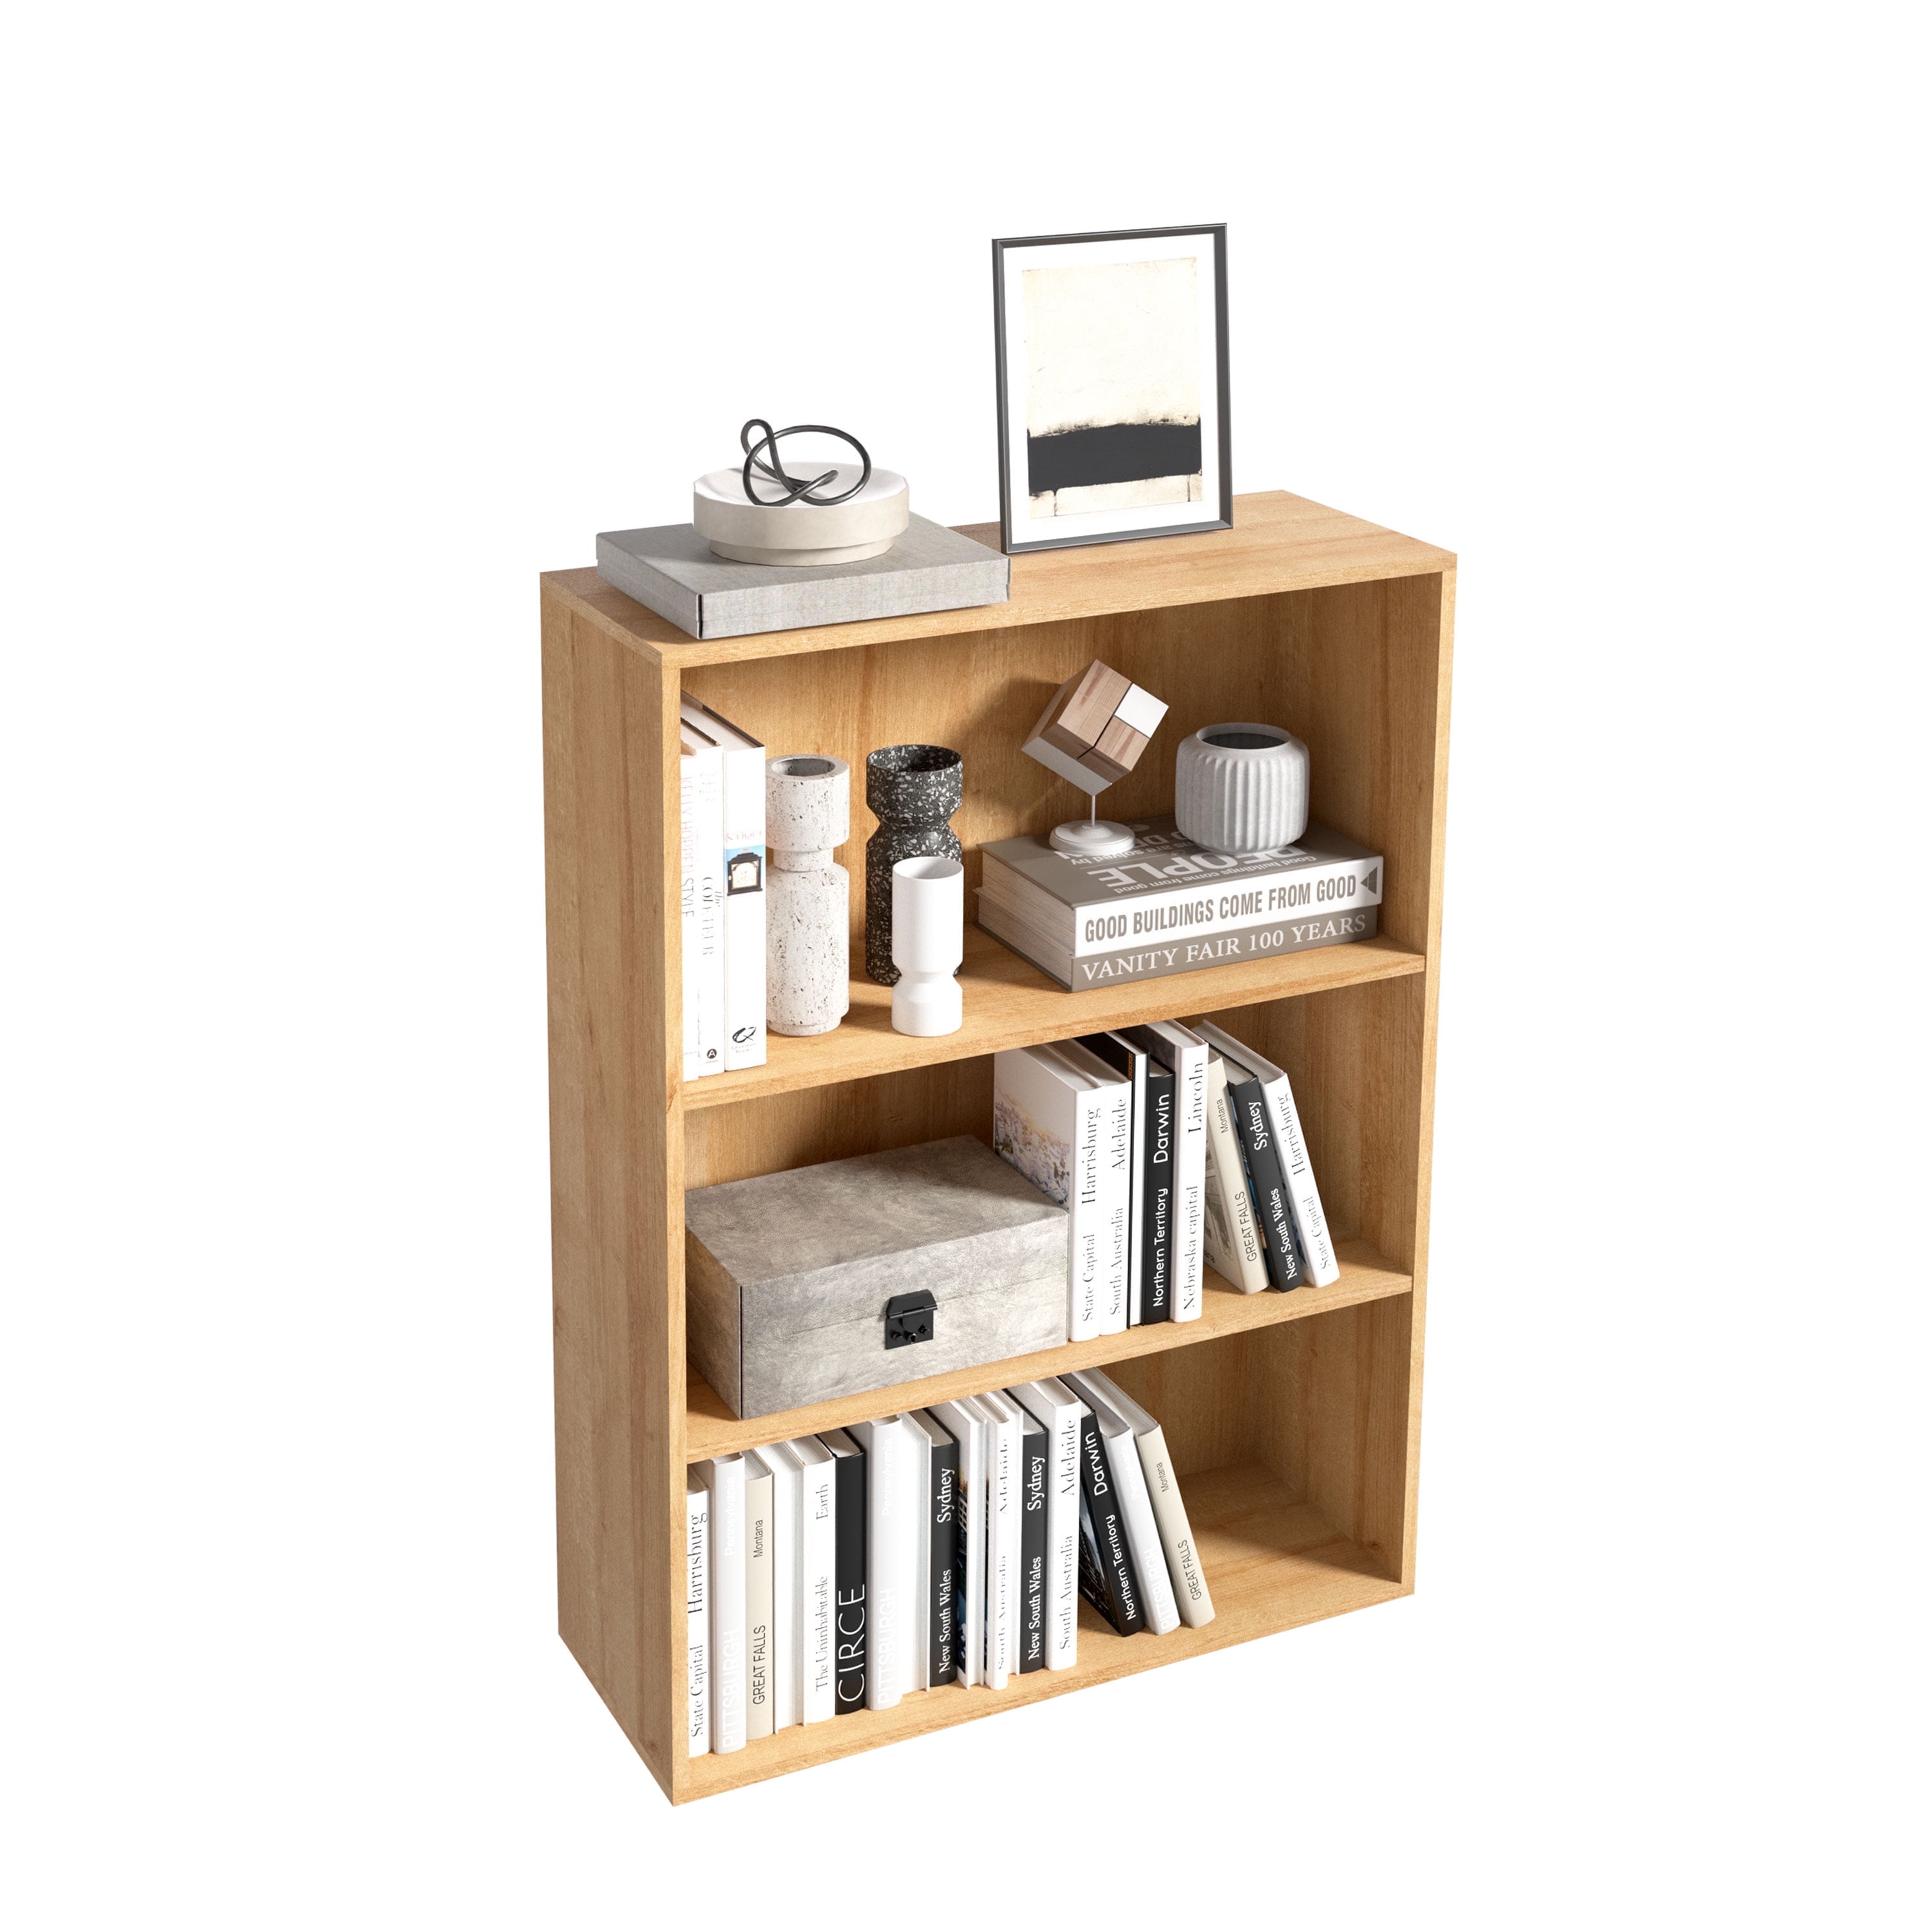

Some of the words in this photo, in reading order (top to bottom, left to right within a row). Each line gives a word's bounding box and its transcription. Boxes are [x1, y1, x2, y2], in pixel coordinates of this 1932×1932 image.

[1149, 878, 1181, 888] from
[1182, 872, 1220, 882] come
[1221, 861, 1281, 875] buildings
[1282, 855, 1317, 866] Good
[1085, 914, 1126, 943] GOOD
[1133, 899, 1214, 934] BUILDINGS
[1219, 891, 1262, 918] COME
[1269, 883, 1311, 910] FROM
[1316, 875, 1356, 902] GOOD
[1113, 884, 1148, 894] good
[1082, 949, 1178, 981] VANITY
[1185, 938, 1241, 963] FAIR
[1248, 931, 1283, 951] 100
[1291, 914, 1366, 942] YEARS
[1188, 1062, 1203, 1133] Lincoln
[1217, 1099, 1229, 1133] Montana
[1112, 1099, 1126, 1170] Adelaide
[1153, 1094, 1170, 1164] Darwin
[1249, 1102, 1268, 1151] Sydney
[1278, 1093, 1305, 1175] Harrisburg
[1082, 1108, 1101, 1204] Harrisburg
[1155, 1188, 1168, 1245] Territory
[1186, 1186, 1200, 1235] capital
[1235, 1191, 1251, 1224] FALLS
[1271, 1188, 1284, 1222] Wales
[1303, 1196, 1321, 1237] Capital
[1083, 1234, 1098, 1282] Capital
[1111, 1208, 1122, 1269] Australia
[1242, 1224, 1257, 1262] GREAT
[1276, 1222, 1292, 1253] South
[1153, 1247, 1164, 1307] Northern
[1184, 1240, 1197, 1310] Nebraska
[1286, 1255, 1298, 1280] New
[1083, 1287, 1093, 1320] State
[1110, 1274, 1121, 1315] South
[882, 1437, 893, 1516] Pennsylvania
[999, 1439, 1009, 1515] Adelaide
[1061, 1419, 1076, 1495] Adelaide
[1085, 1432, 1108, 1496] Darwin
[1157, 1462, 1169, 1492] Montana
[816, 1484, 828, 1520] Earth
[937, 1468, 955, 1522] Sydney
[1027, 1457, 1045, 1510] Sydney
[753, 1519, 764, 1558] Montana
[1106, 1515, 1123, 1567] Territory
[1177, 1539, 1194, 1569] FALLS
[688, 1513, 707, 1613] Harrisburg
[1030, 1557, 1041, 1593] Wales
[1061, 1535, 1073, 1602] Australia
[1186, 1569, 1202, 1600] GREAT
[940, 1569, 952, 1605] Wales
[1119, 1567, 1136, 1620] Northern
[1144, 1550, 1174, 1631] PITTSBURGH
[815, 1575, 828, 1662] Uninhabitable
[939, 1607, 951, 1641] South
[1028, 1595, 1040, 1629] South
[1059, 1607, 1071, 1649] South
[753, 1625, 766, 1662] FALLS
[838, 1584, 865, 1701] CIRCE
[877, 1587, 896, 1705] PITTSBURGH
[939, 1646, 951, 1674] New
[1028, 1633, 1040, 1661] New
[690, 1645, 707, 1695] Capital
[723, 1630, 741, 1748] PITTSBURGH
[753, 1663, 764, 1705] GREAT
[816, 1664, 828, 1691] The
[690, 1700, 703, 1737] State
